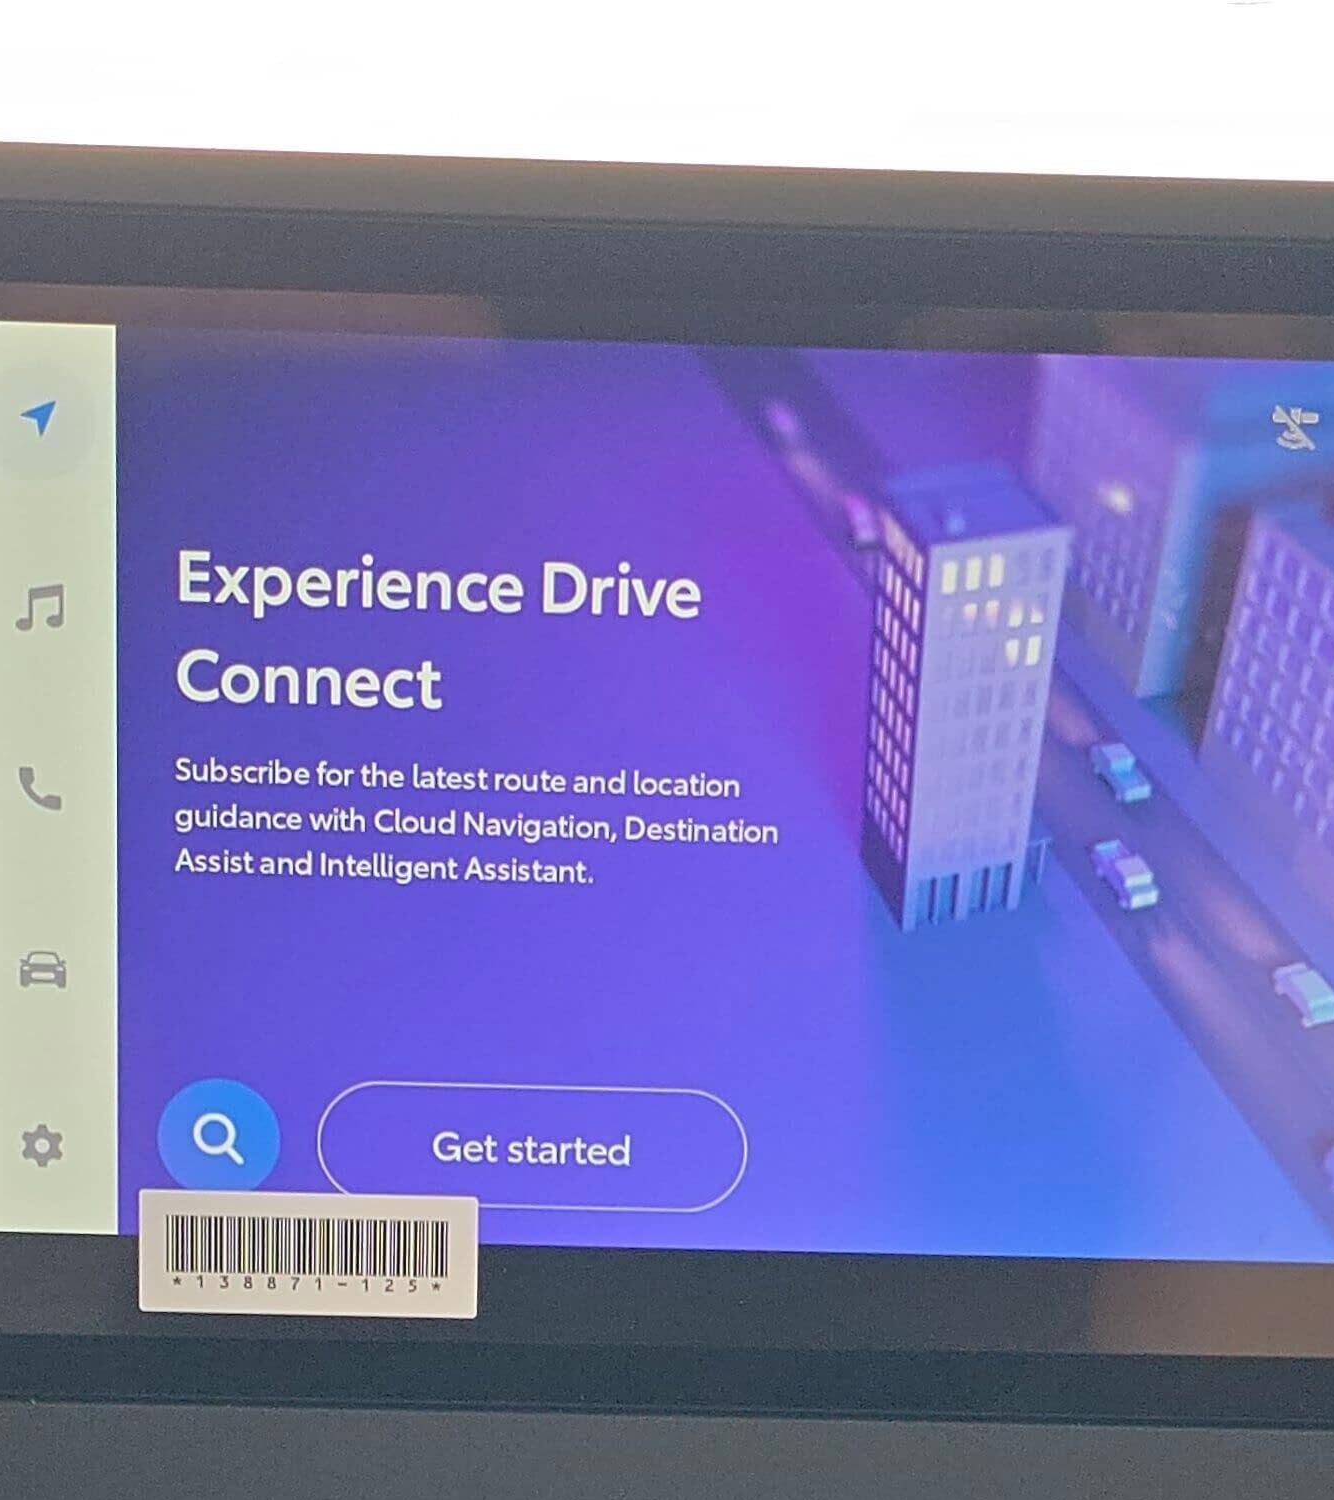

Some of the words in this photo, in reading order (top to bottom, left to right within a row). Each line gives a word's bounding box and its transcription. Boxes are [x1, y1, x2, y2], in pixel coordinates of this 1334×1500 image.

[178, 549, 524, 618] Experience
[542, 561, 702, 619] Drive
[176, 648, 443, 710] Connect
[174, 757, 310, 786] Subscribe
[315, 761, 355, 787] for
[360, 762, 404, 789] the
[412, 763, 488, 792] latest
[494, 769, 566, 794] route
[573, 768, 626, 795] and
[633, 769, 741, 798] location
[174, 805, 302, 833] guidance
[309, 808, 367, 832] with
[374, 809, 455, 836] Cloud
[463, 811, 618, 844] Navigation,
[624, 815, 779, 845] Destination
[174, 848, 254, 875] Assist
[260, 850, 313, 876] and
[319, 851, 457, 885] Intelligent
[464, 855, 595, 884] Assistant.
[431, 1131, 499, 1165] Get
[509, 1133, 631, 1168] started
